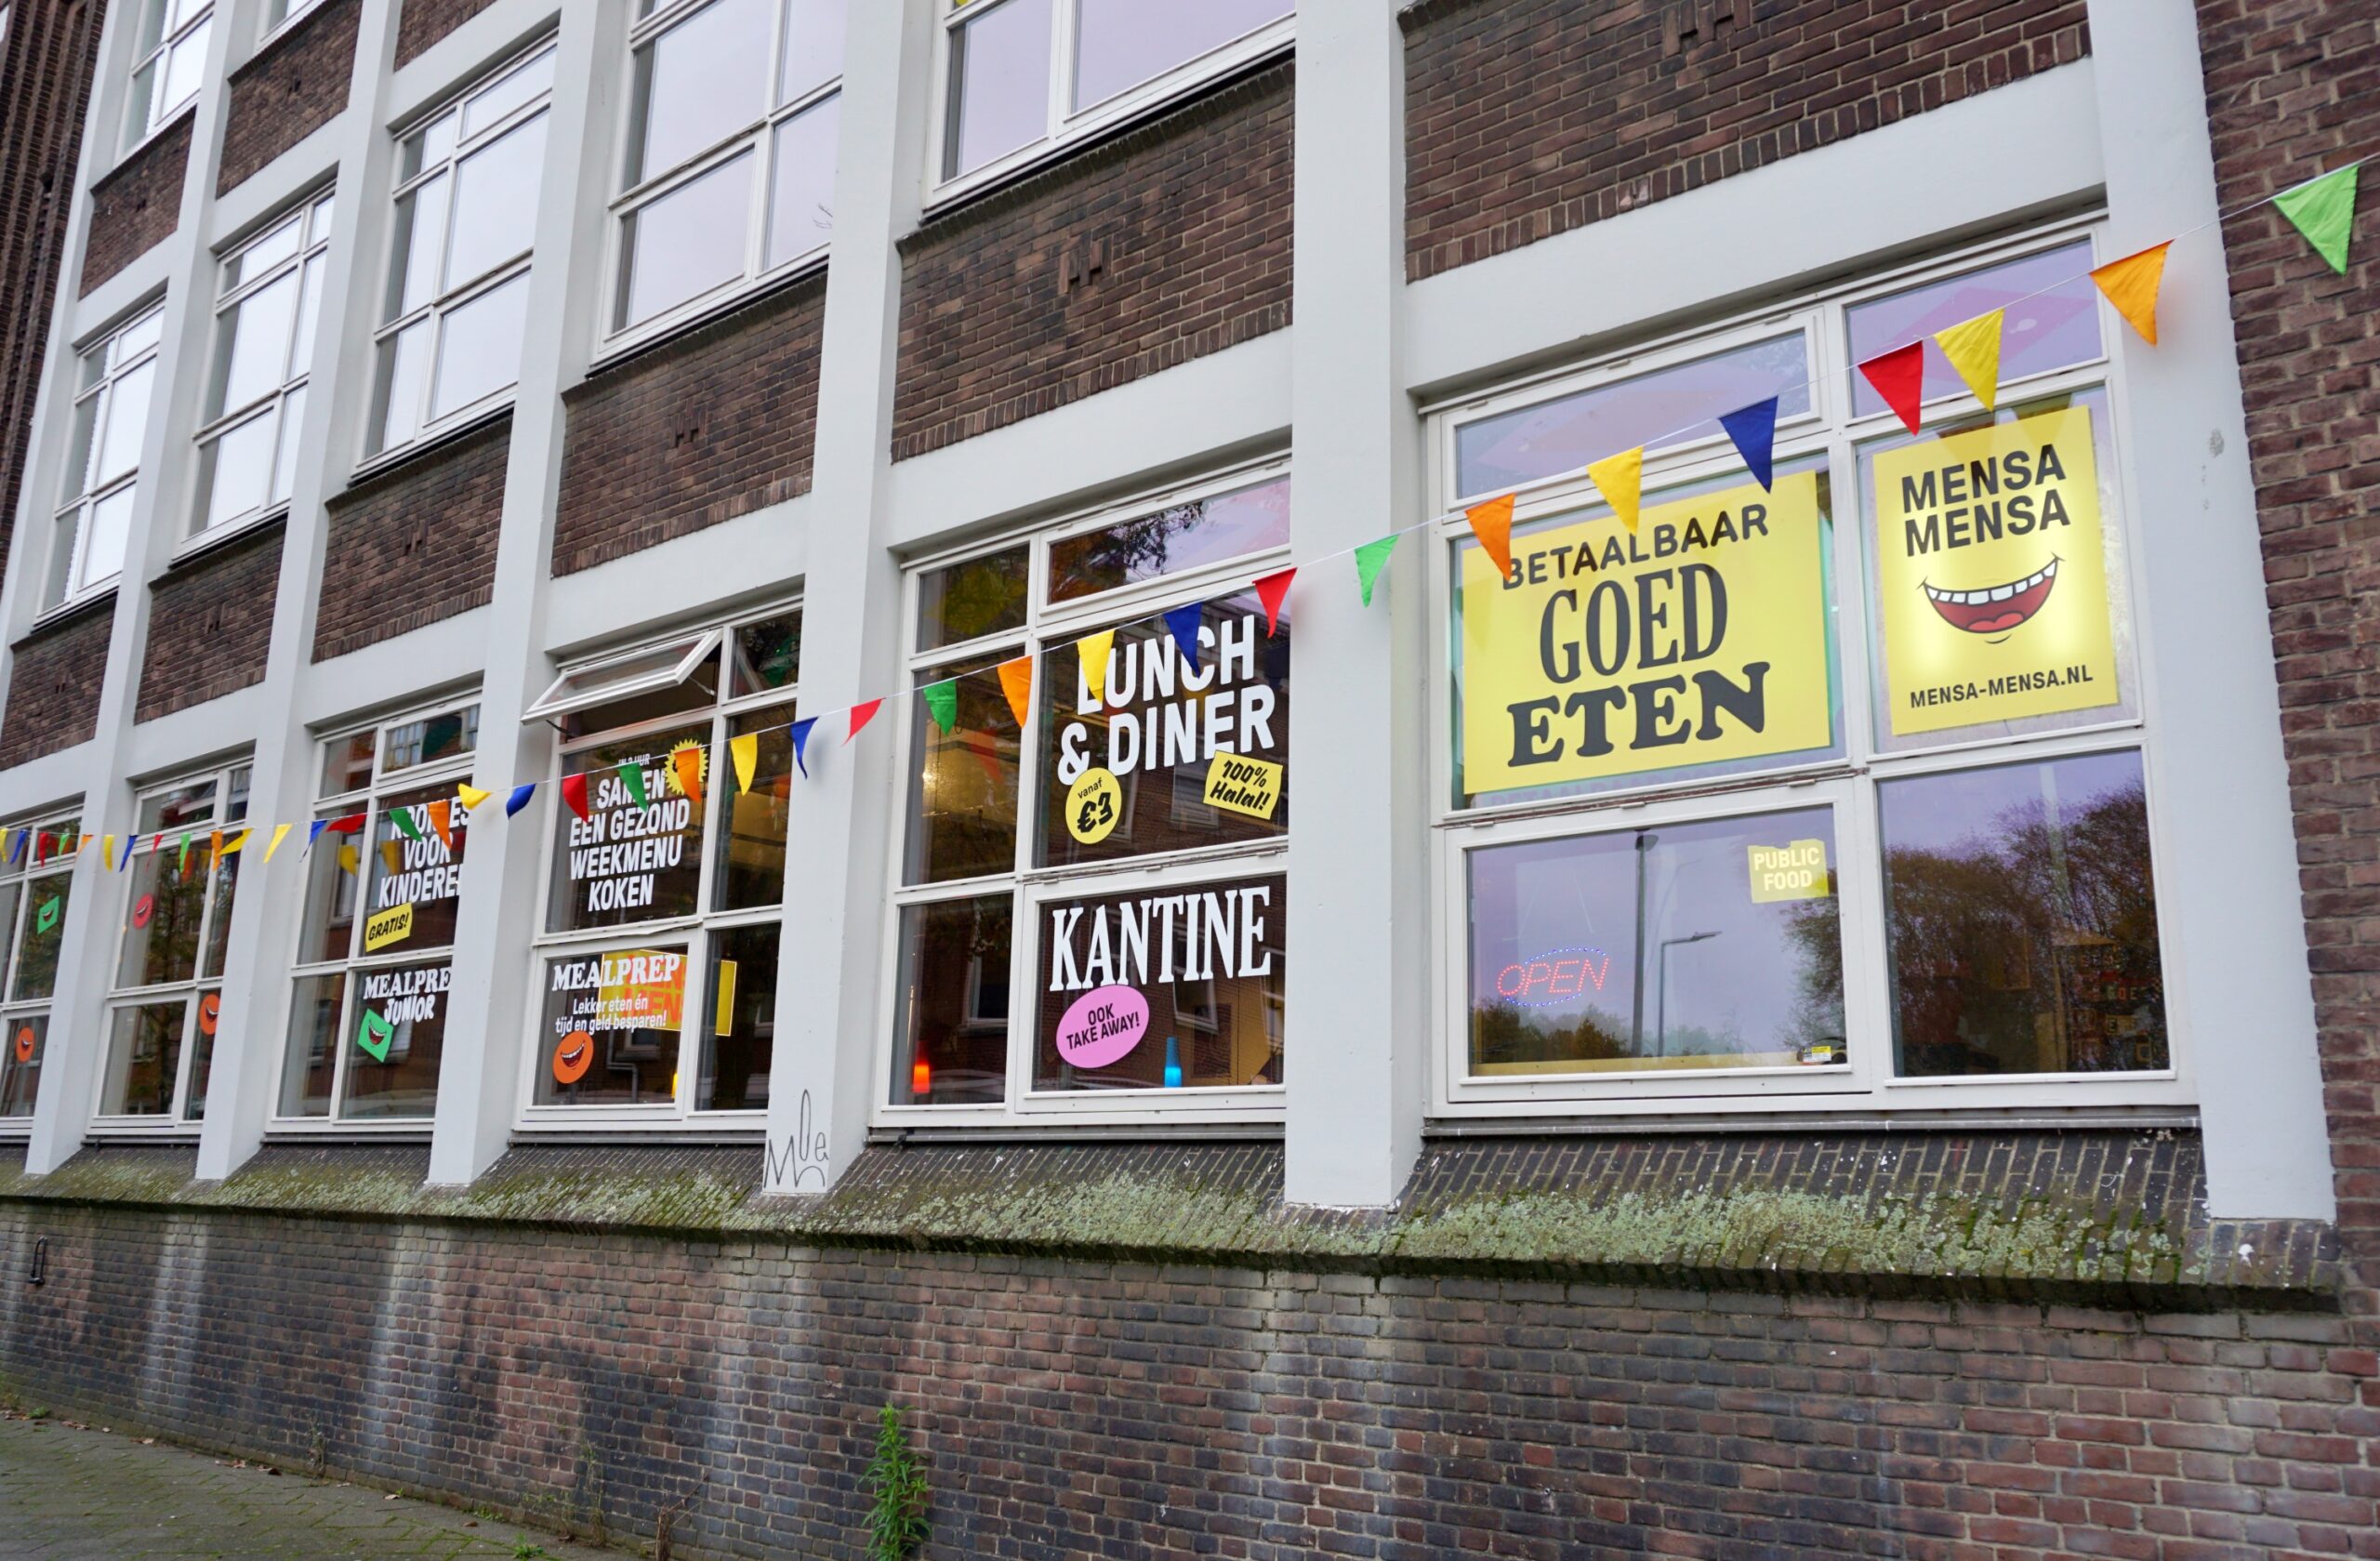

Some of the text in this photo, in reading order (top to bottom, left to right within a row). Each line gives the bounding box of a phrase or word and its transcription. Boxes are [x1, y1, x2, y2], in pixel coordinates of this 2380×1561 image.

[1901, 443, 2067, 513] MENSA
[1905, 489, 2070, 557] MENSA
[1502, 504, 1768, 589] BETAALBAAR
[1540, 562, 1727, 683] GOED
[1078, 615, 1255, 715] LUNCH
[1911, 665, 2094, 708] MENSA-MENSA.NL
[1507, 661, 1770, 767] ETEN
[1057, 684, 1276, 786] & DINER
[1078, 776, 1103, 799] vanaf
[1222, 760, 1268, 787] 100%
[1077, 792, 1114, 833] €3
[1210, 780, 1271, 811] Halal!
[569, 798, 691, 847] EEN GEZOND
[404, 831, 454, 870] VOOR
[570, 834, 682, 880] WEEKMENU
[1753, 847, 1820, 871] PUBLIC
[378, 863, 463, 908] KINDERE
[588, 874, 654, 912] KOKEN
[1764, 868, 1813, 891] FOOD
[368, 912, 410, 941] GRATIS!
[1049, 885, 1271, 991] KANTINE
[551, 953, 681, 991] MEALPREP
[1496, 957, 1609, 997] OPEN
[384, 994, 435, 1025] JUNIOR
[555, 1009, 668, 1037] tijd en geld besparen!
[573, 992, 649, 1015] Lekker eten én
[1088, 1002, 1114, 1026] OOK
[1066, 1011, 1141, 1050] TAKE AWAY!
